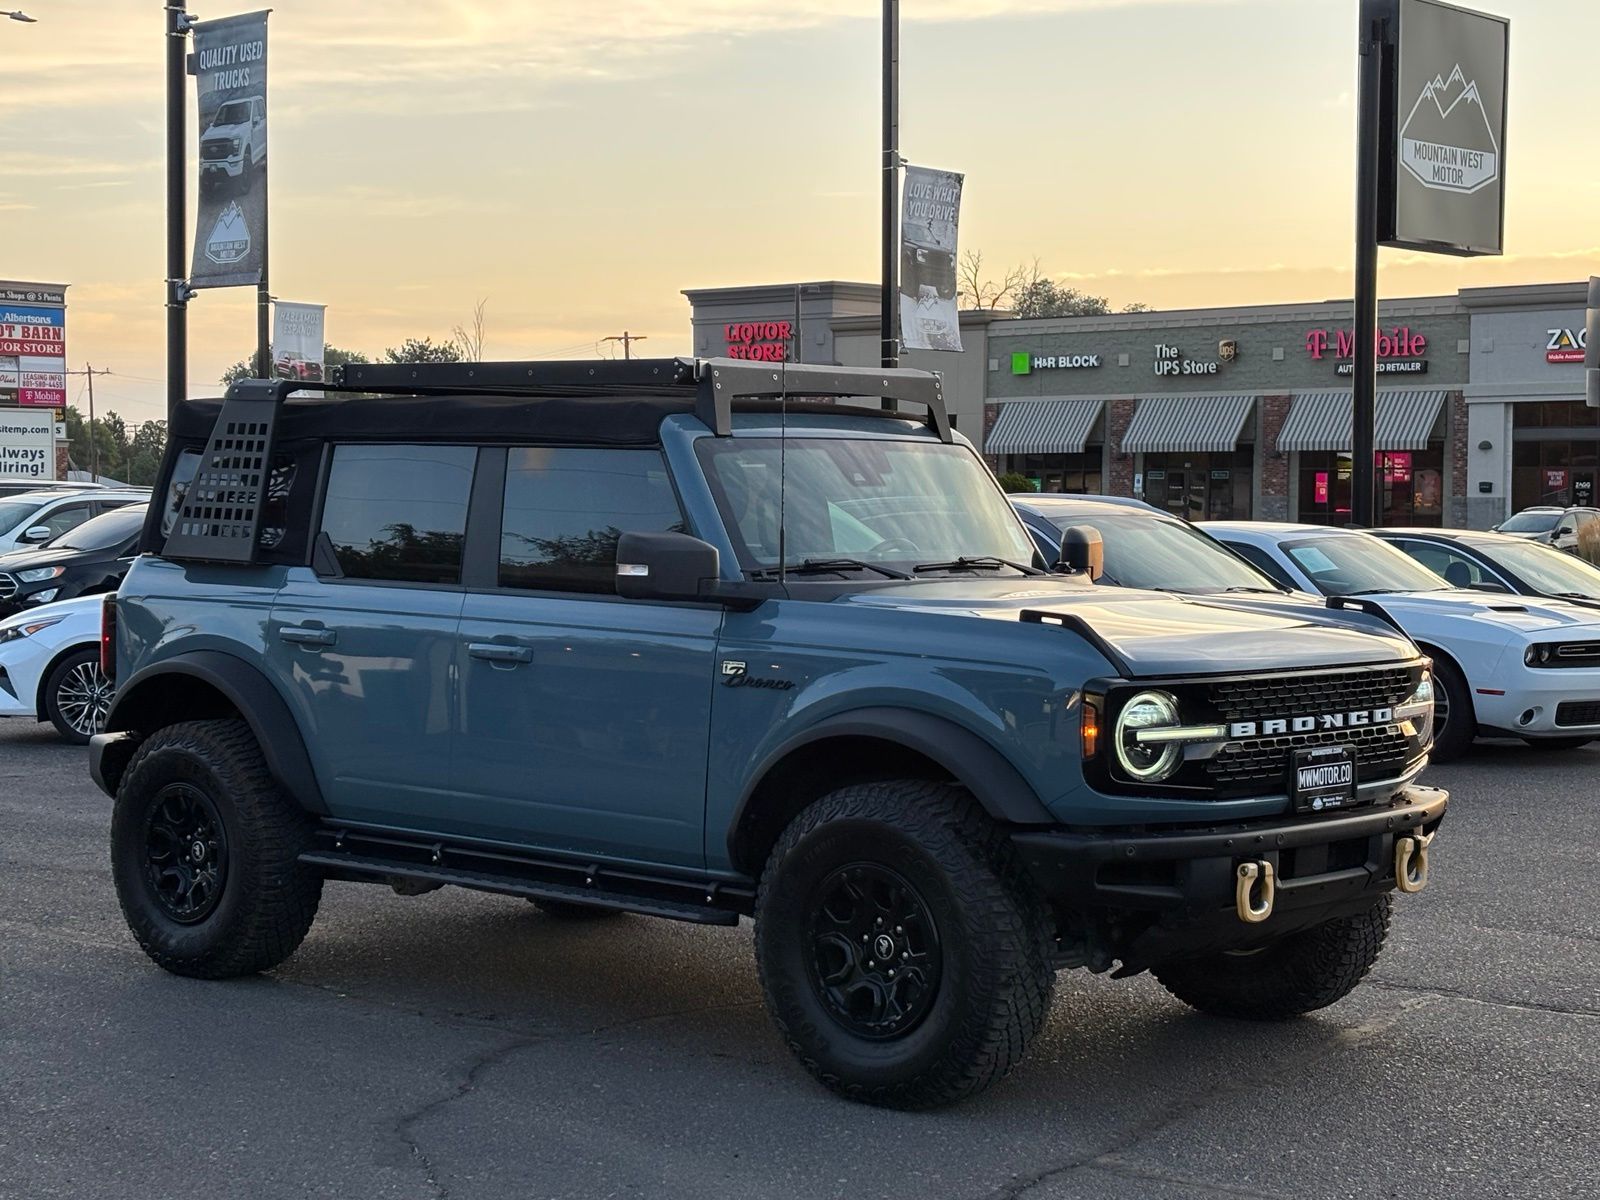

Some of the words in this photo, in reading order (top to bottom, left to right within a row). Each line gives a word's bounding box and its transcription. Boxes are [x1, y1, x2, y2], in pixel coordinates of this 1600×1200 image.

[200, 45, 237, 69] QUALITY
[240, 41, 263, 62] USED
[214, 68, 250, 90] TRUCKS
[1414, 142, 1457, 164] MOUNTAIN
[1460, 149, 1484, 170] WEST
[1432, 164, 1463, 184] MOTOR
[908, 182, 931, 199] LOVE
[933, 185, 958, 203] WHAT
[909, 200, 927, 217] YOU
[929, 203, 955, 221] DRIVE
[26, 292, 36, 301] @
[4, 312, 52, 324] Albertsons
[21, 326, 62, 340] BARN
[724, 320, 792, 345] LIQUOR
[23, 343, 63, 354] STORE
[726, 343, 785, 361] STORE
[1154, 343, 1179, 359] The
[1034, 356, 1056, 369] H&R
[1058, 354, 1099, 368] BLOCK
[1154, 360, 1181, 375] UPS
[1183, 359, 1217, 374] Store
[1386, 362, 1422, 373] RETAILER
[23, 373, 47, 381] LEASING
[49, 374, 63, 382] INFO
[0, 446, 45, 462] lways
[0, 461, 45, 476] iring!
[721, 666, 796, 690] Bronco
[1230, 708, 1393, 737] BRONCO
[1299, 764, 1351, 788] MWMOTOR.CO
